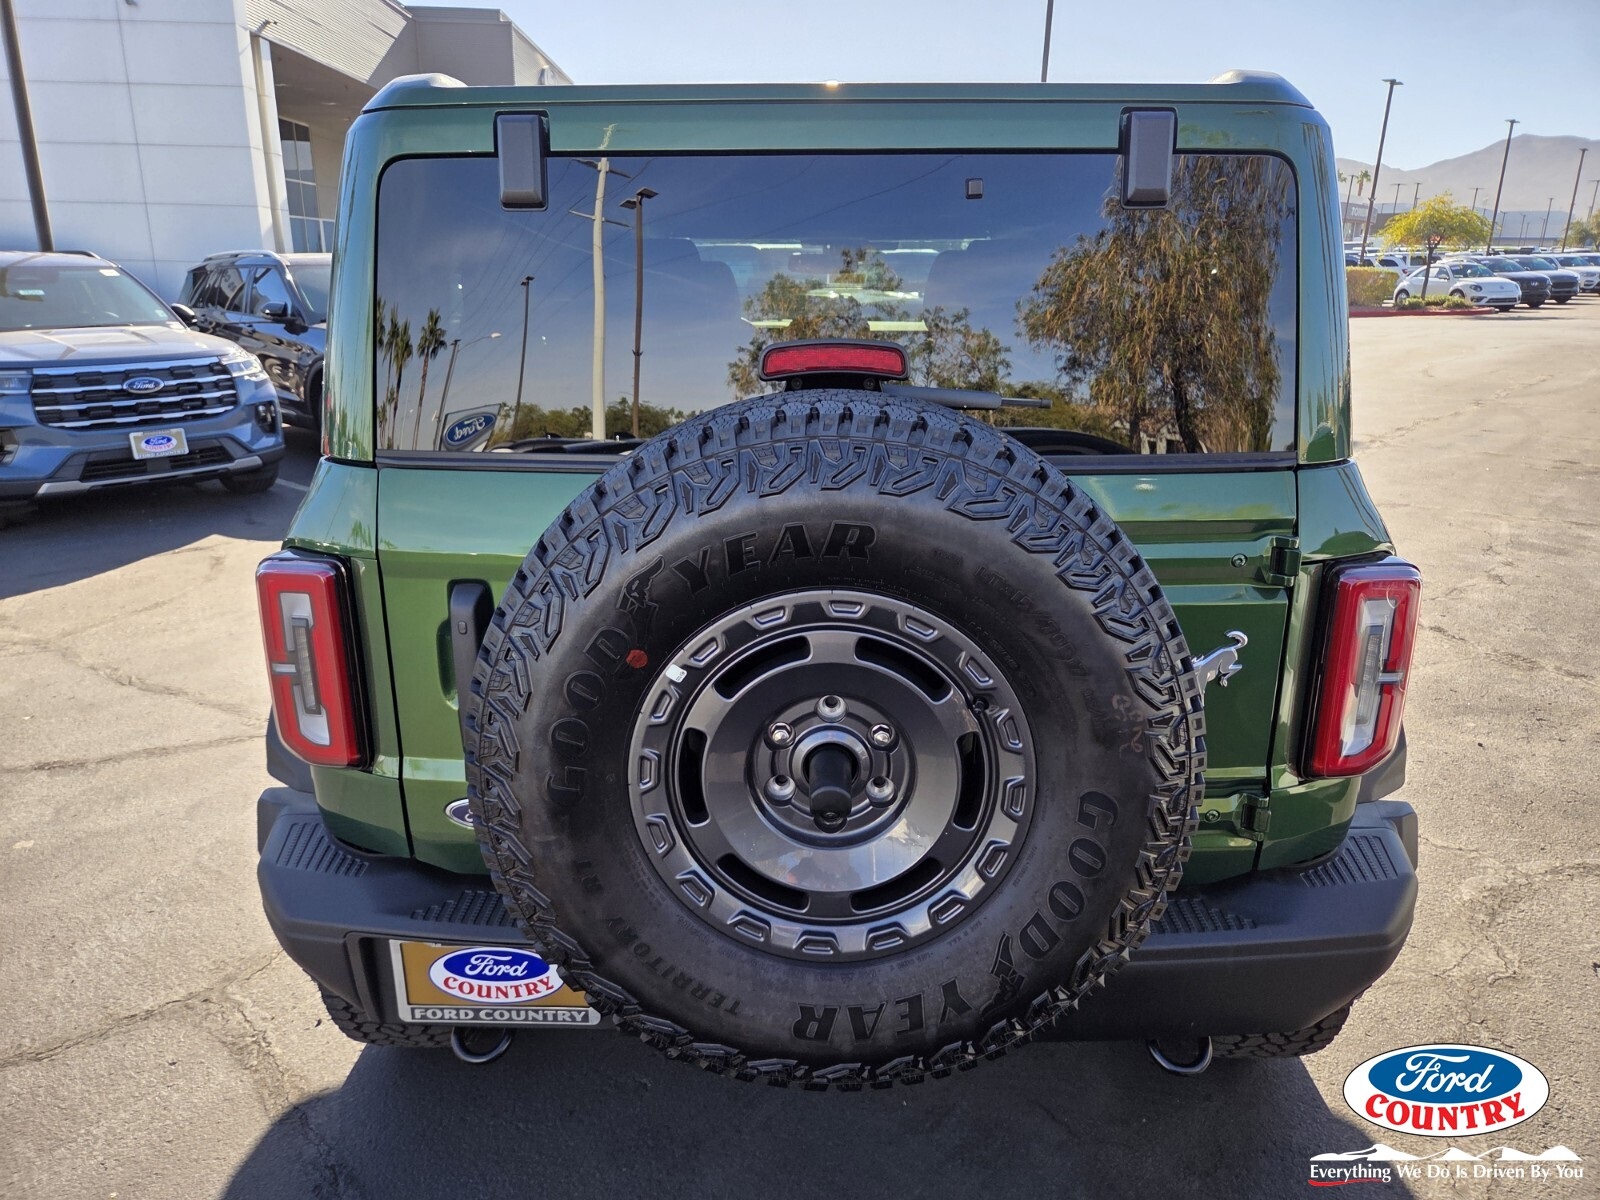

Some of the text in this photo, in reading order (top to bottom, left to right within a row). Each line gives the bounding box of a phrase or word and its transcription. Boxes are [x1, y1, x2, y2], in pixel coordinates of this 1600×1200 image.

[133, 380, 155, 389] Ford
[464, 954, 528, 977] Ford
[443, 976, 555, 999] COUNTRY
[414, 1008, 587, 1022] FORD COUNTRY
